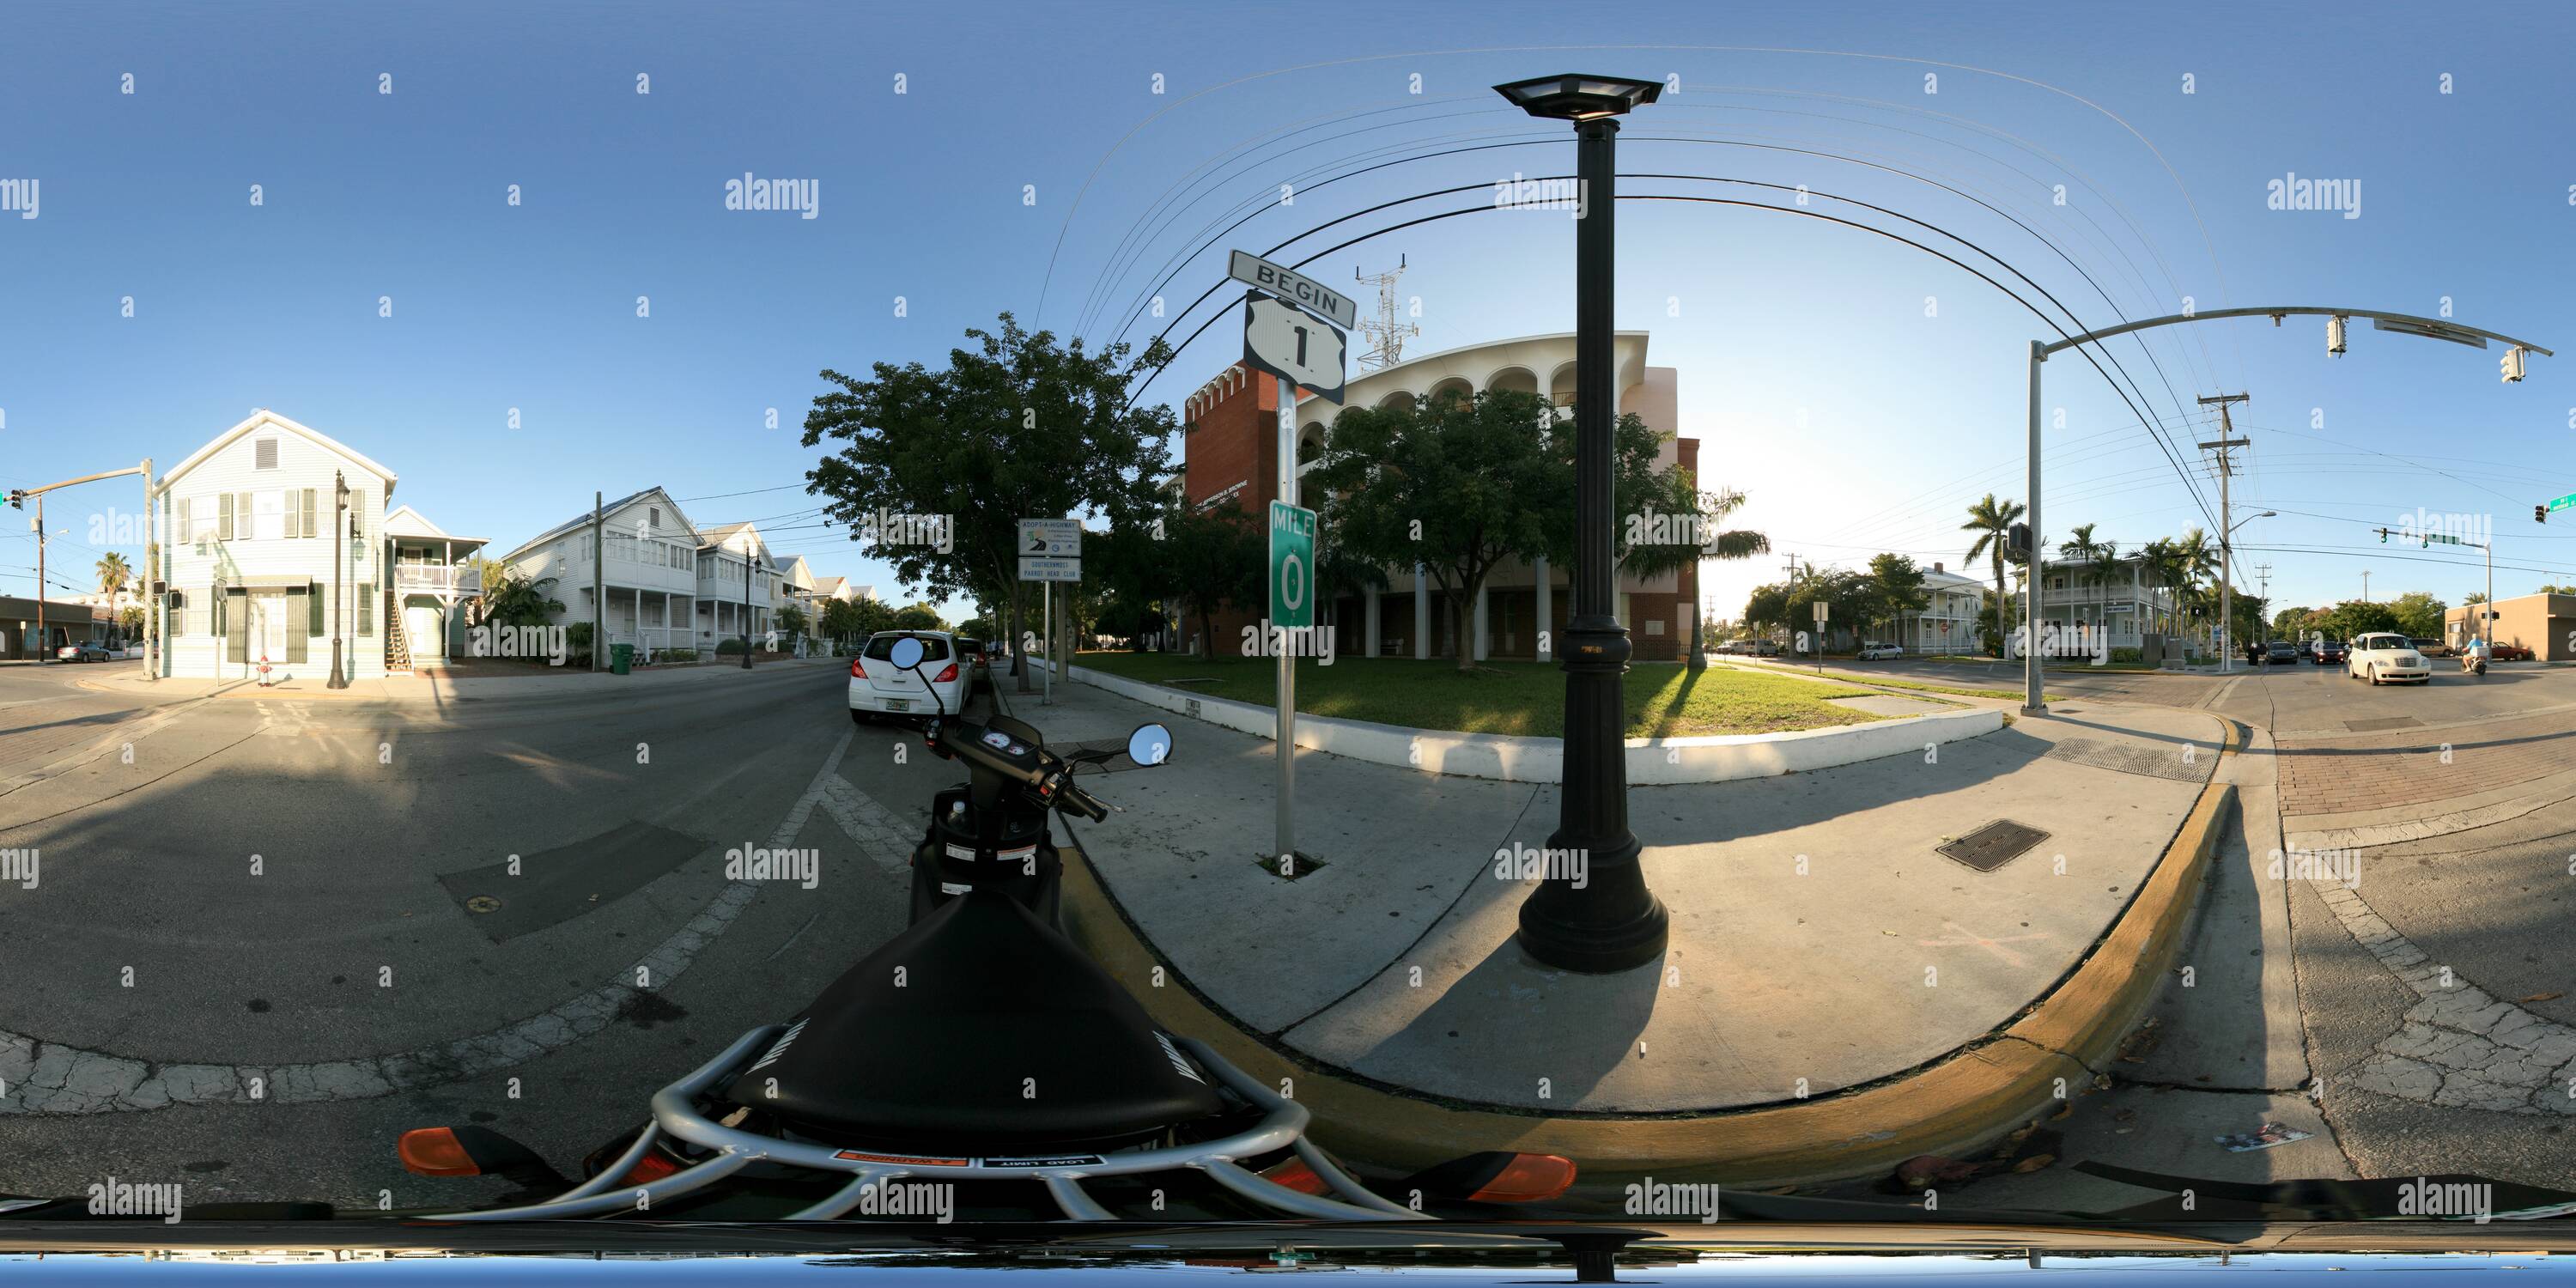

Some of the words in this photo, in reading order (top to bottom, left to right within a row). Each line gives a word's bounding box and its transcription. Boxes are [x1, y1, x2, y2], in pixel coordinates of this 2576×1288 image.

[1257, 264, 1337, 315] BEGIN
[1294, 325, 1309, 368] 1
[1274, 512, 1313, 538] MILE
[1281, 554, 1304, 611] 0
[854, 1153, 933, 1165] WARNING
